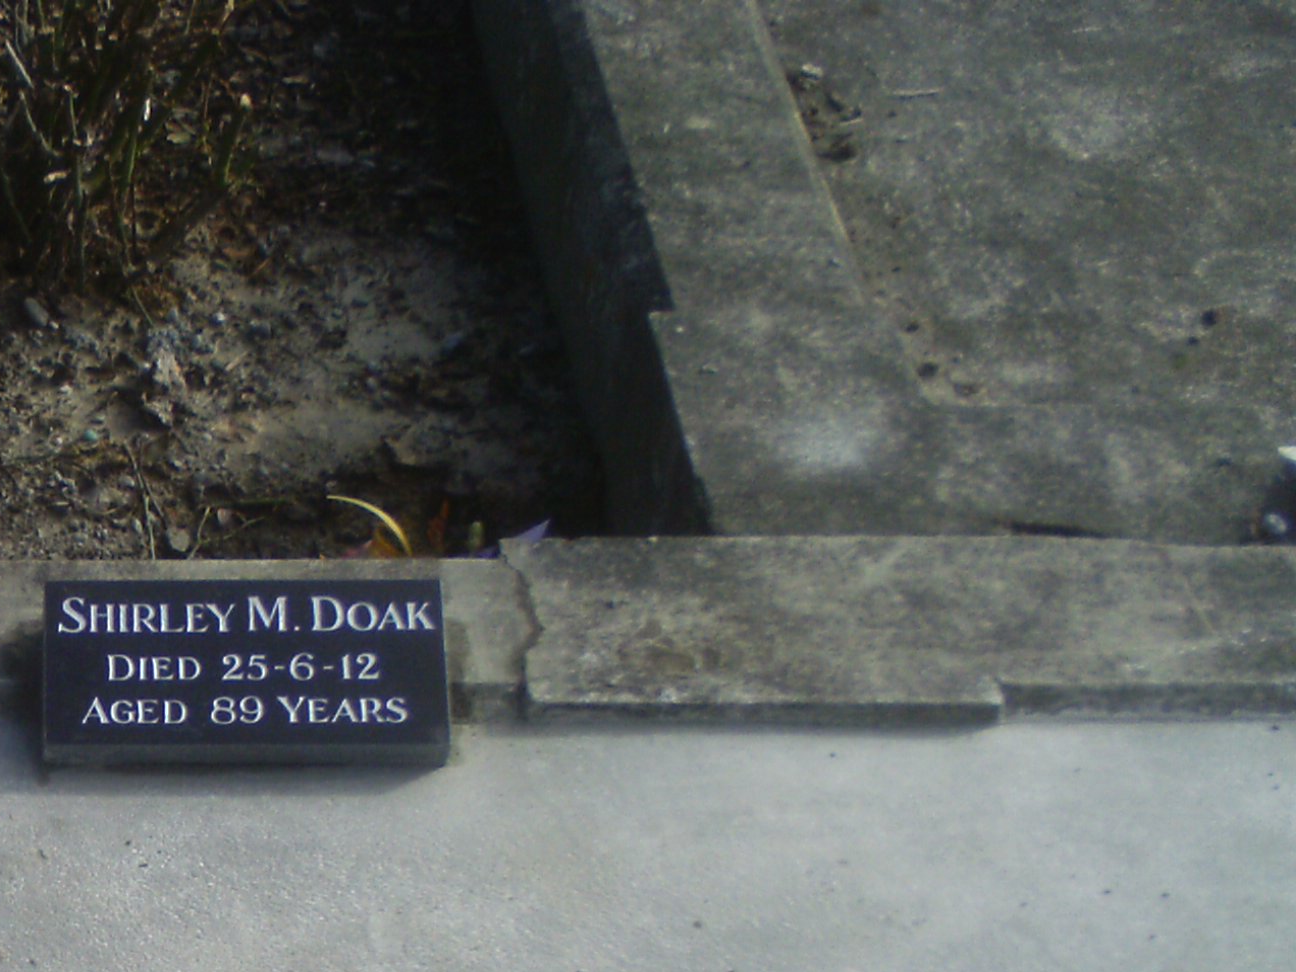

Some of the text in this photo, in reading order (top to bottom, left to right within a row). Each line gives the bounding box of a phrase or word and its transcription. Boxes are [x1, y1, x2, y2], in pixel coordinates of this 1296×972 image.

[57, 595, 435, 633] SHIRLEY M. DOAK
[107, 653, 380, 681] DIED 25-6-12
[82, 696, 409, 725] AGED 89 YEARS
